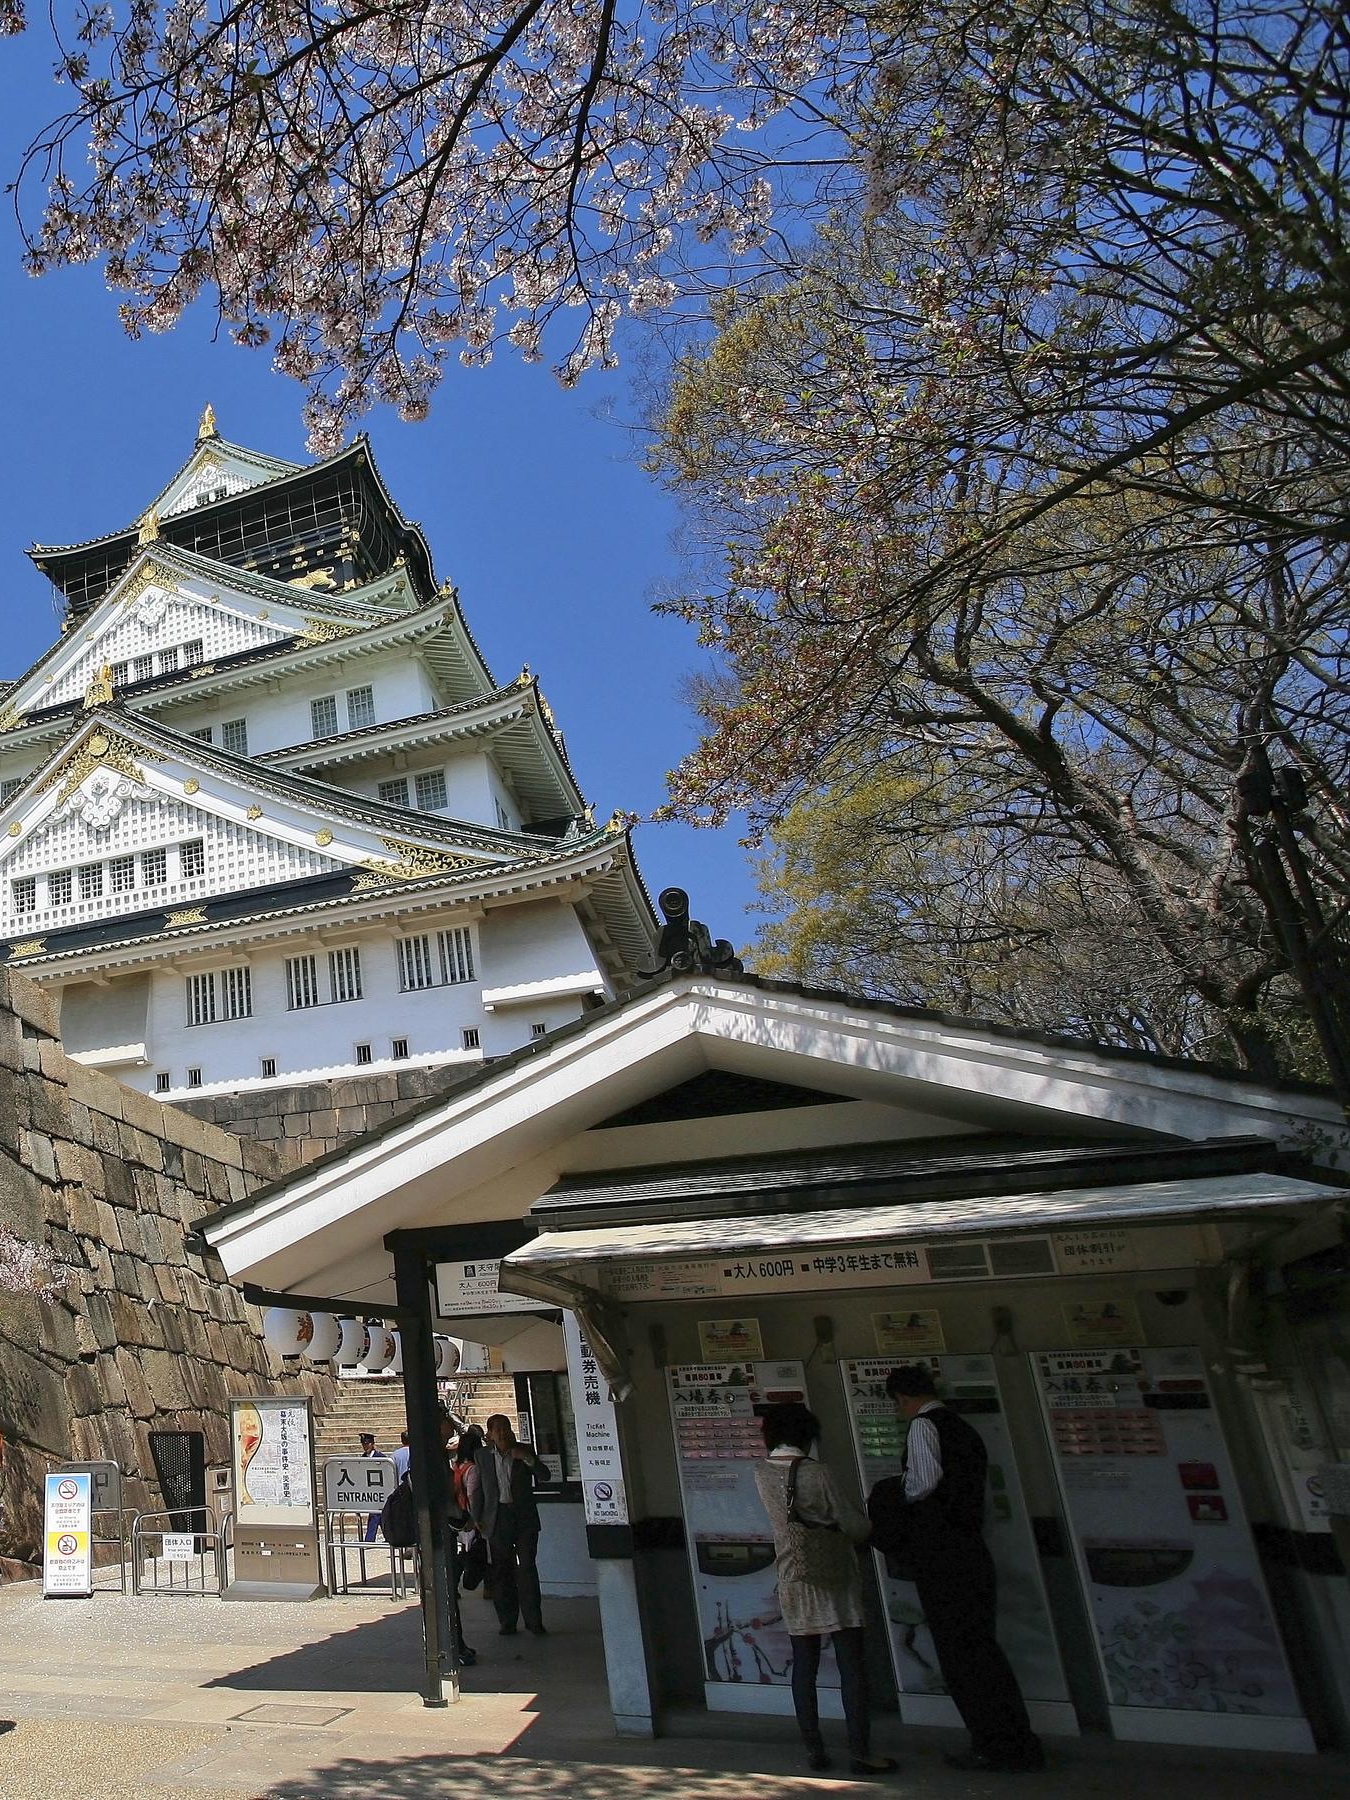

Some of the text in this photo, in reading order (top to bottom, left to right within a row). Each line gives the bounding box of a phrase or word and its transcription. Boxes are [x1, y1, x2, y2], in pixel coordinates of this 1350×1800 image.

[734, 1259, 794, 1279] 大人600円
[813, 1250, 920, 1274] 中学3年生まで無料
[673, 1388, 723, 1405] 入場券
[851, 1383, 887, 1400] 入場
[336, 1468, 385, 1487] 入口
[337, 1491, 385, 1504] ENTRANCE
[164, 1538, 192, 1546] 団体入口
